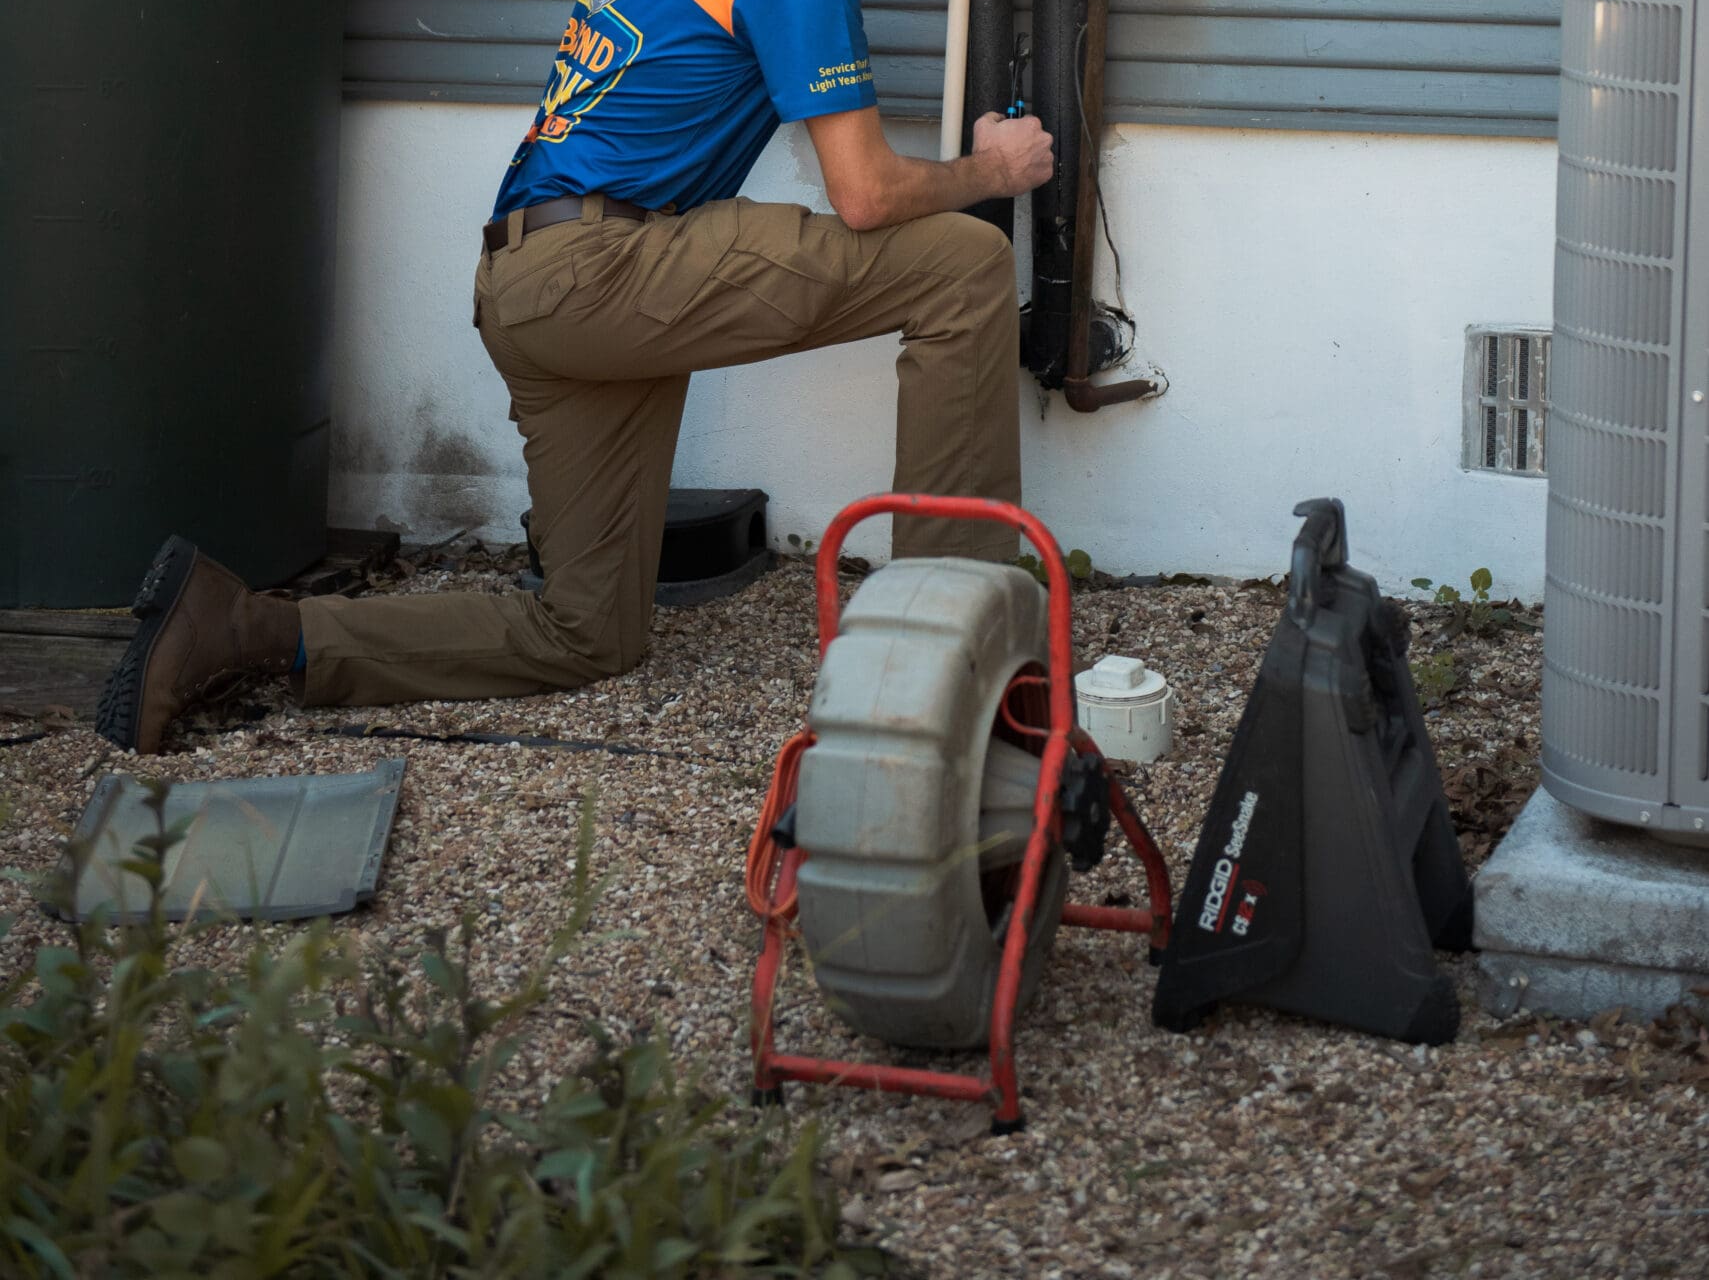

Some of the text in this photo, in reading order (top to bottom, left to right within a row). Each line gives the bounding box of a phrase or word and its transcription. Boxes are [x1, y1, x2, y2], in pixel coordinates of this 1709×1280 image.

[818, 62, 856, 78] Service
[809, 78, 836, 93] Light
[1199, 791, 1259, 932] RIDGID SeeSnake
